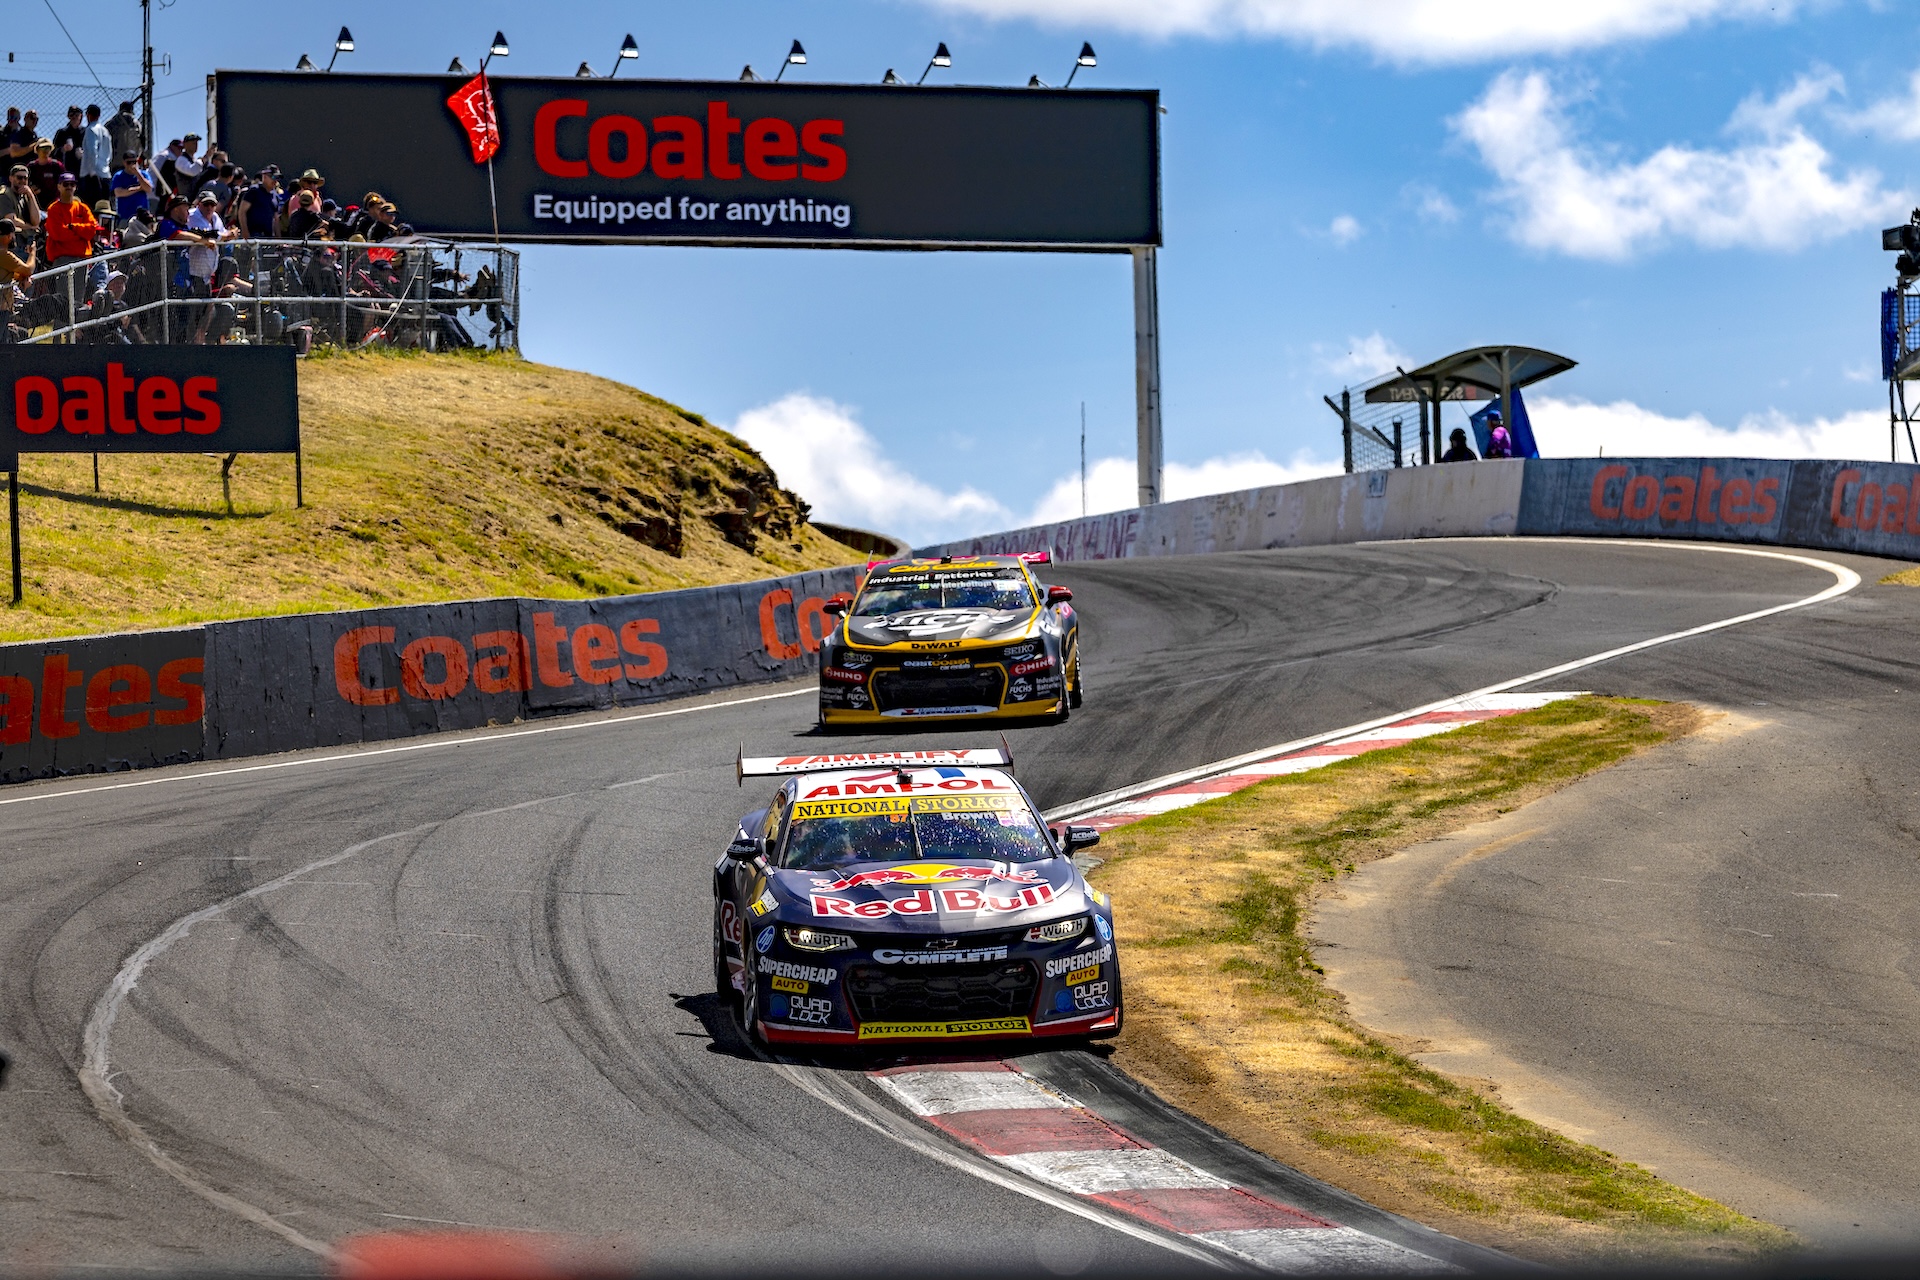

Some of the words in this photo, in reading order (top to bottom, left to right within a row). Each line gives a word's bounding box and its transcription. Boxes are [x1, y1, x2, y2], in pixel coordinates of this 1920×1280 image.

[534, 98, 848, 182] Coates
[534, 195, 672, 224] Equipped
[679, 196, 720, 220] for
[726, 199, 850, 228] anything
[15, 362, 221, 435] oates
[1590, 464, 1779, 524] Coates
[869, 573, 930, 585] Industrial
[935, 570, 995, 580] Batteries
[930, 580, 992, 589] Wnterbottom
[843, 652, 873, 663] SEIKO
[1003, 643, 1035, 656] SEIKO
[334, 611, 669, 706] Coates
[834, 670, 862, 681] HINO
[847, 692, 869, 702] FUCHS
[1009, 684, 1033, 694] FUCHS
[806, 749, 972, 765] AMPLIFY
[803, 779, 1011, 800] AMPOL
[798, 800, 906, 818] NATIONAL
[916, 796, 1022, 812] STORAGE
[941, 811, 995, 822] Brown
[809, 889, 937, 919] Red
[938, 883, 1055, 914] Bull
[872, 948, 1008, 965] COMPLETE
[1045, 943, 1112, 978] SUPERCHEAP
[758, 955, 838, 985] SUPERCHEAP
[1070, 969, 1096, 982] AUTO
[775, 979, 805, 990] AUTO
[1074, 981, 1109, 999] QUAD
[790, 995, 832, 1013] QUAD
[1074, 993, 1110, 1010] LOCK
[789, 1008, 832, 1025] LOCK
[862, 1025, 944, 1035] NATIONAL
[951, 1020, 1025, 1032] STORAGE
